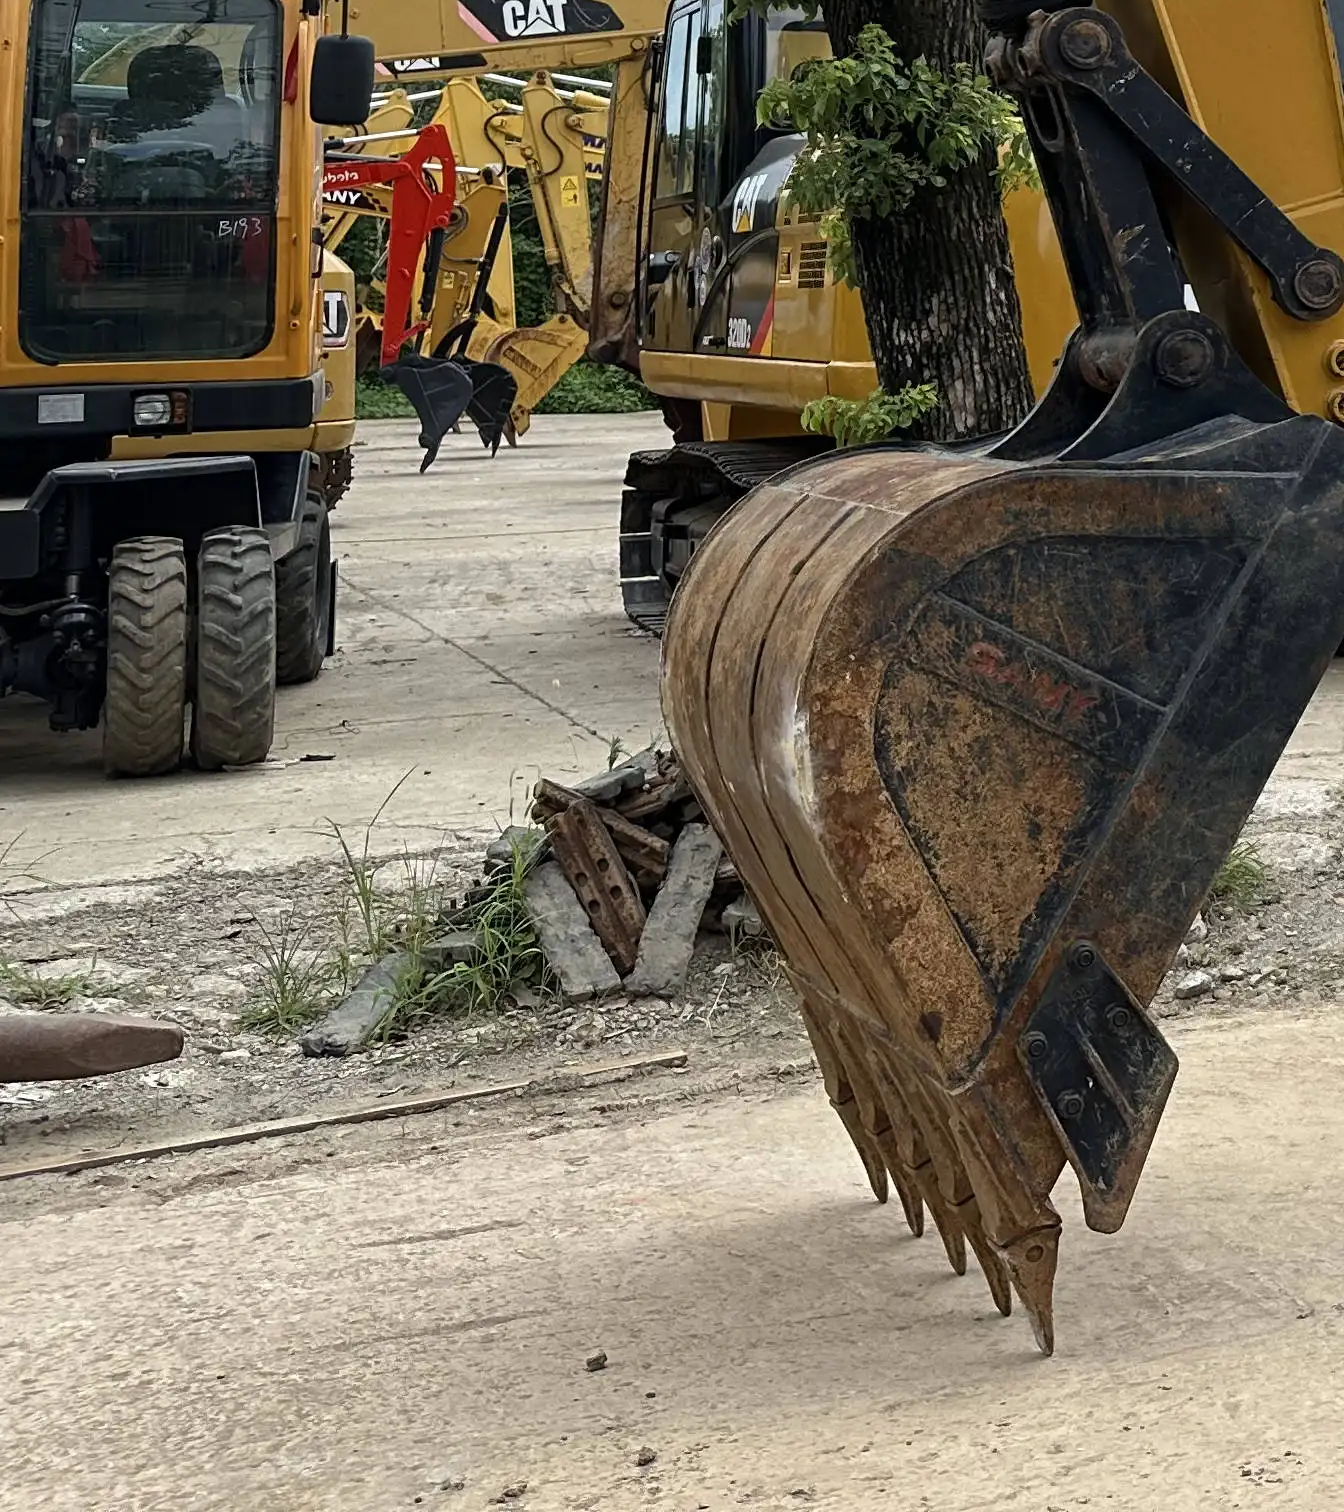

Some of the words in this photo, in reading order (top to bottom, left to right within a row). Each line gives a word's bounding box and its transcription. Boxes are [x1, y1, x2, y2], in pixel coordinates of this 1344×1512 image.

[321, 170, 359, 184] ubota
[321, 189, 361, 205] ANY
[731, 173, 768, 233] CAT
[218, 217, 262, 239] B193
